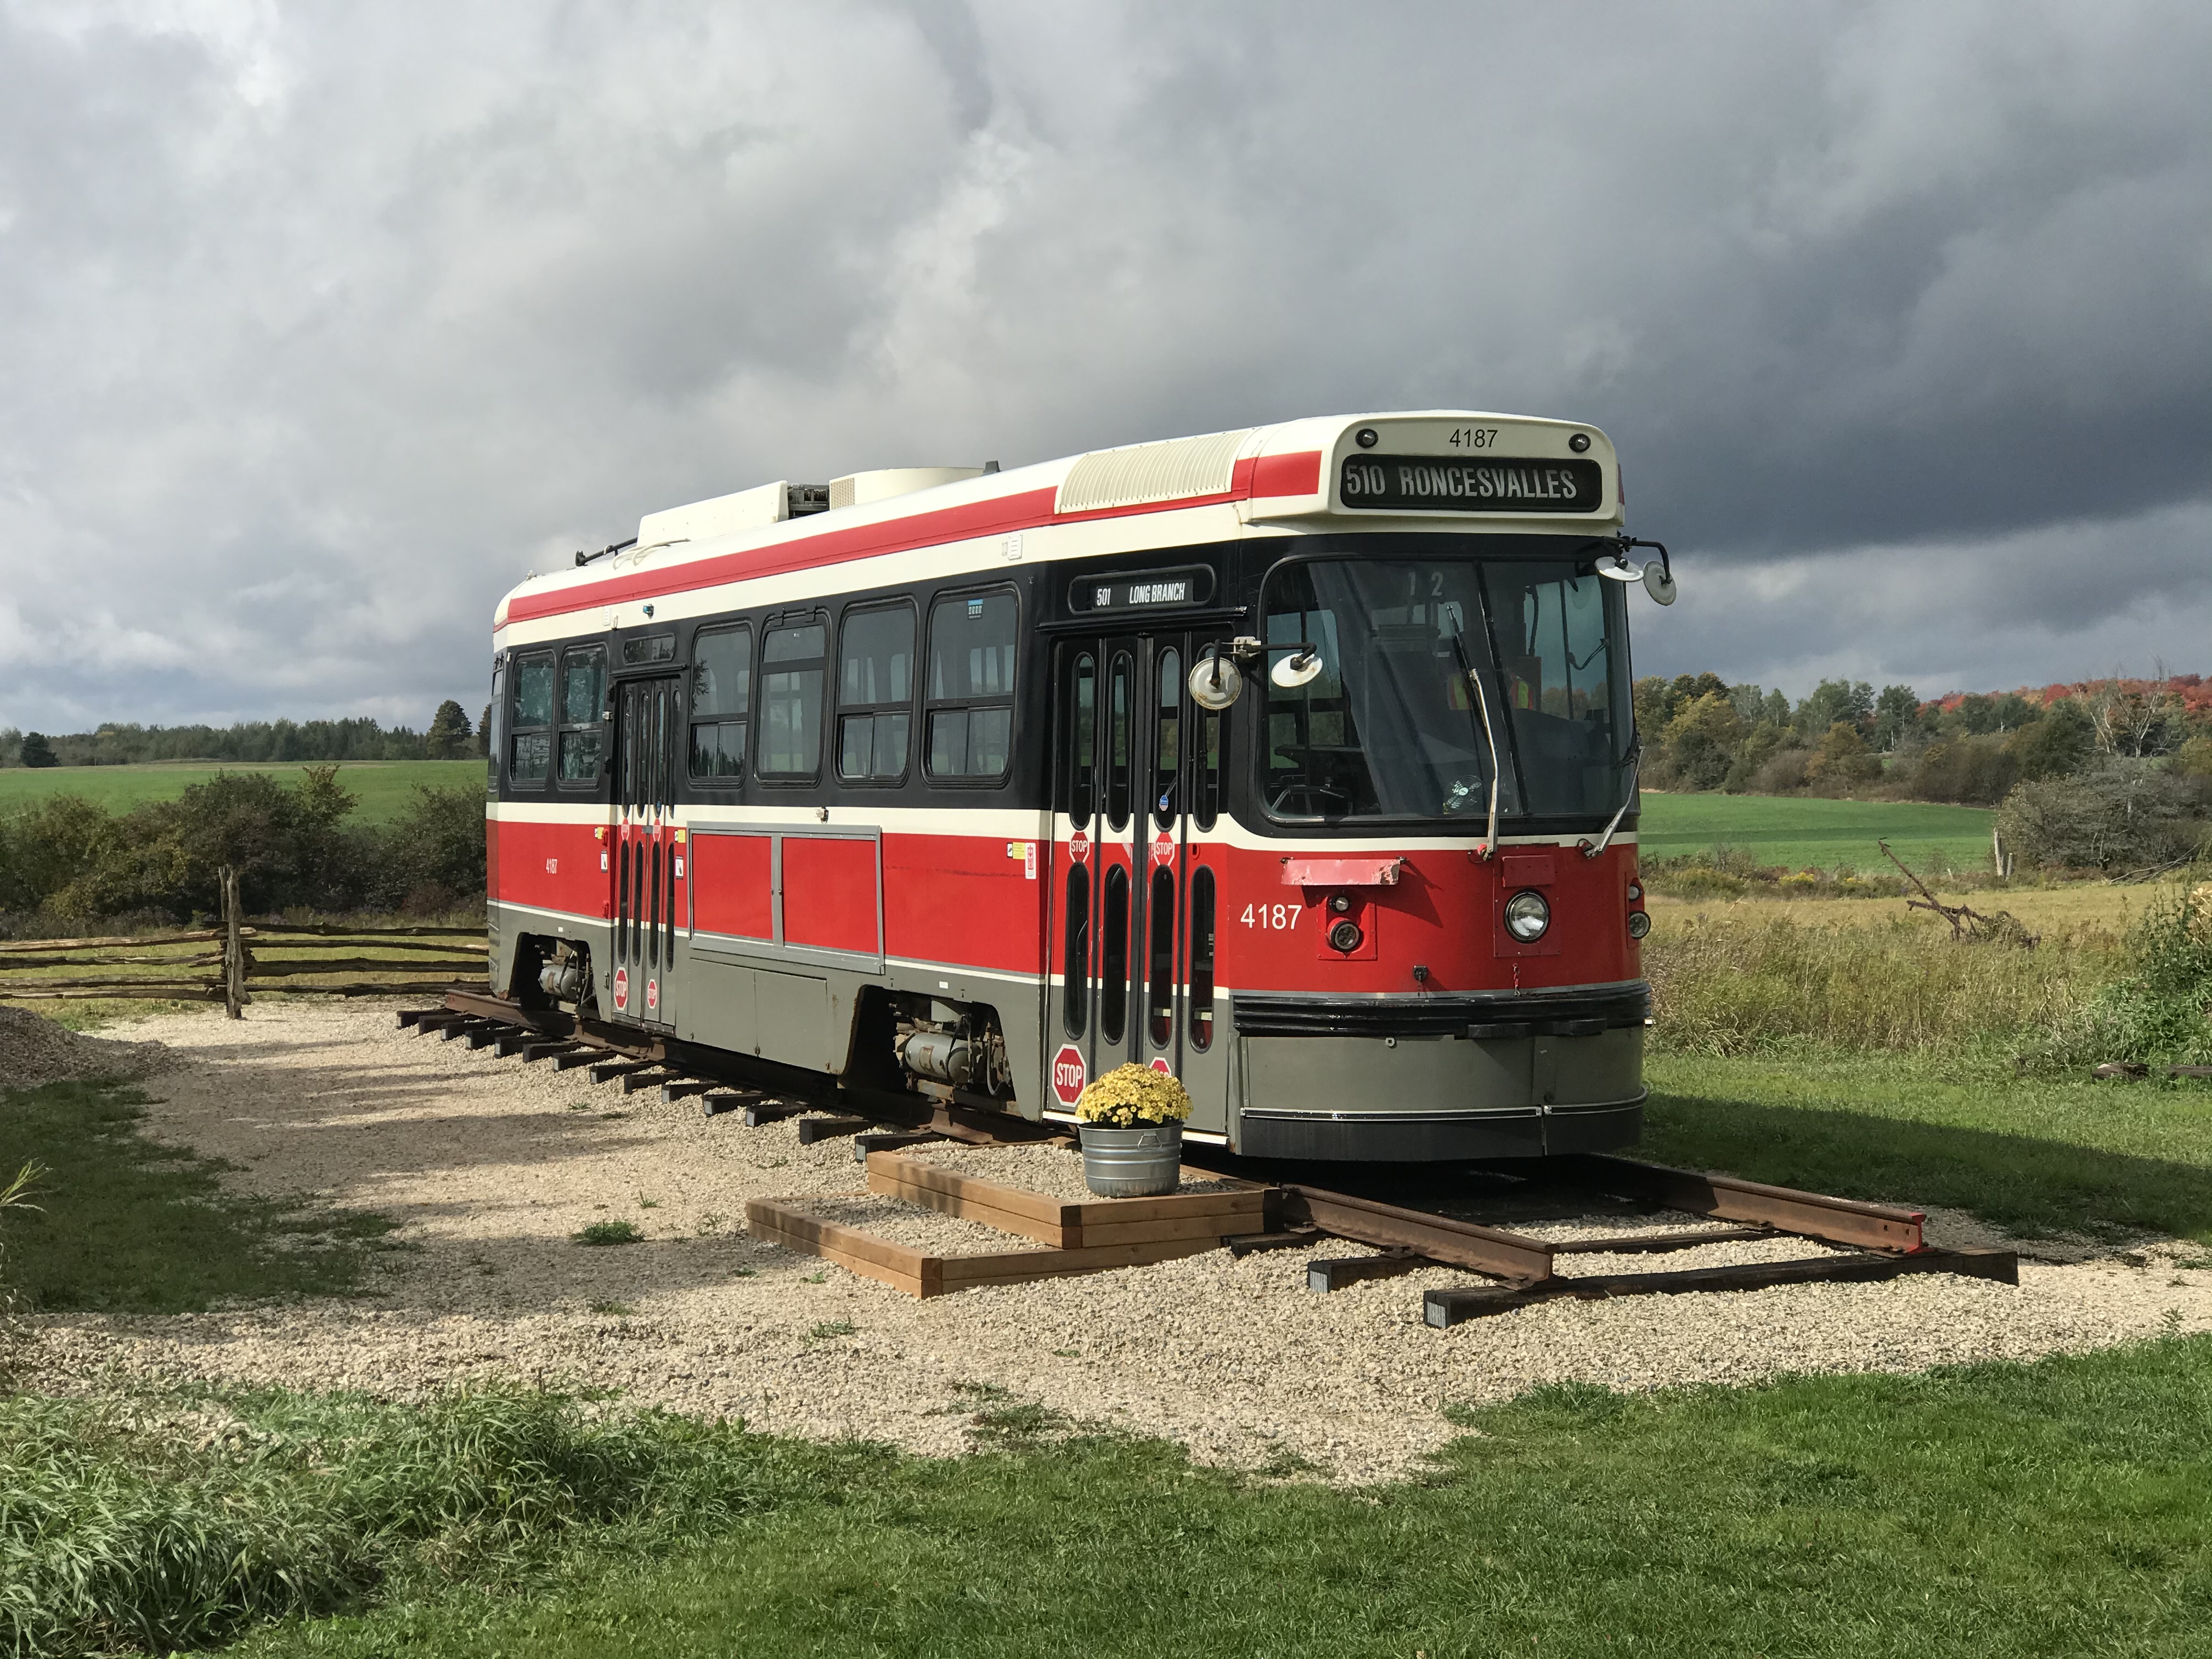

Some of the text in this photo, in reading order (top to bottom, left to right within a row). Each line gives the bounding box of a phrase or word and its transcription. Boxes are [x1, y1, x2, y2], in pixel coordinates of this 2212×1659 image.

[1449, 429, 1498, 448] 4187
[1346, 465, 1577, 499] 510 RONCESVALLES
[1097, 583, 1185, 606] 501 LONG BRANCH
[1071, 839, 1087, 853] STOP
[1156, 842, 1172, 855] STOP
[546, 858, 557, 874] 4187
[1240, 903, 1302, 929] 4187
[616, 980, 627, 997] STOP
[1056, 1062, 1082, 1088] STOP
